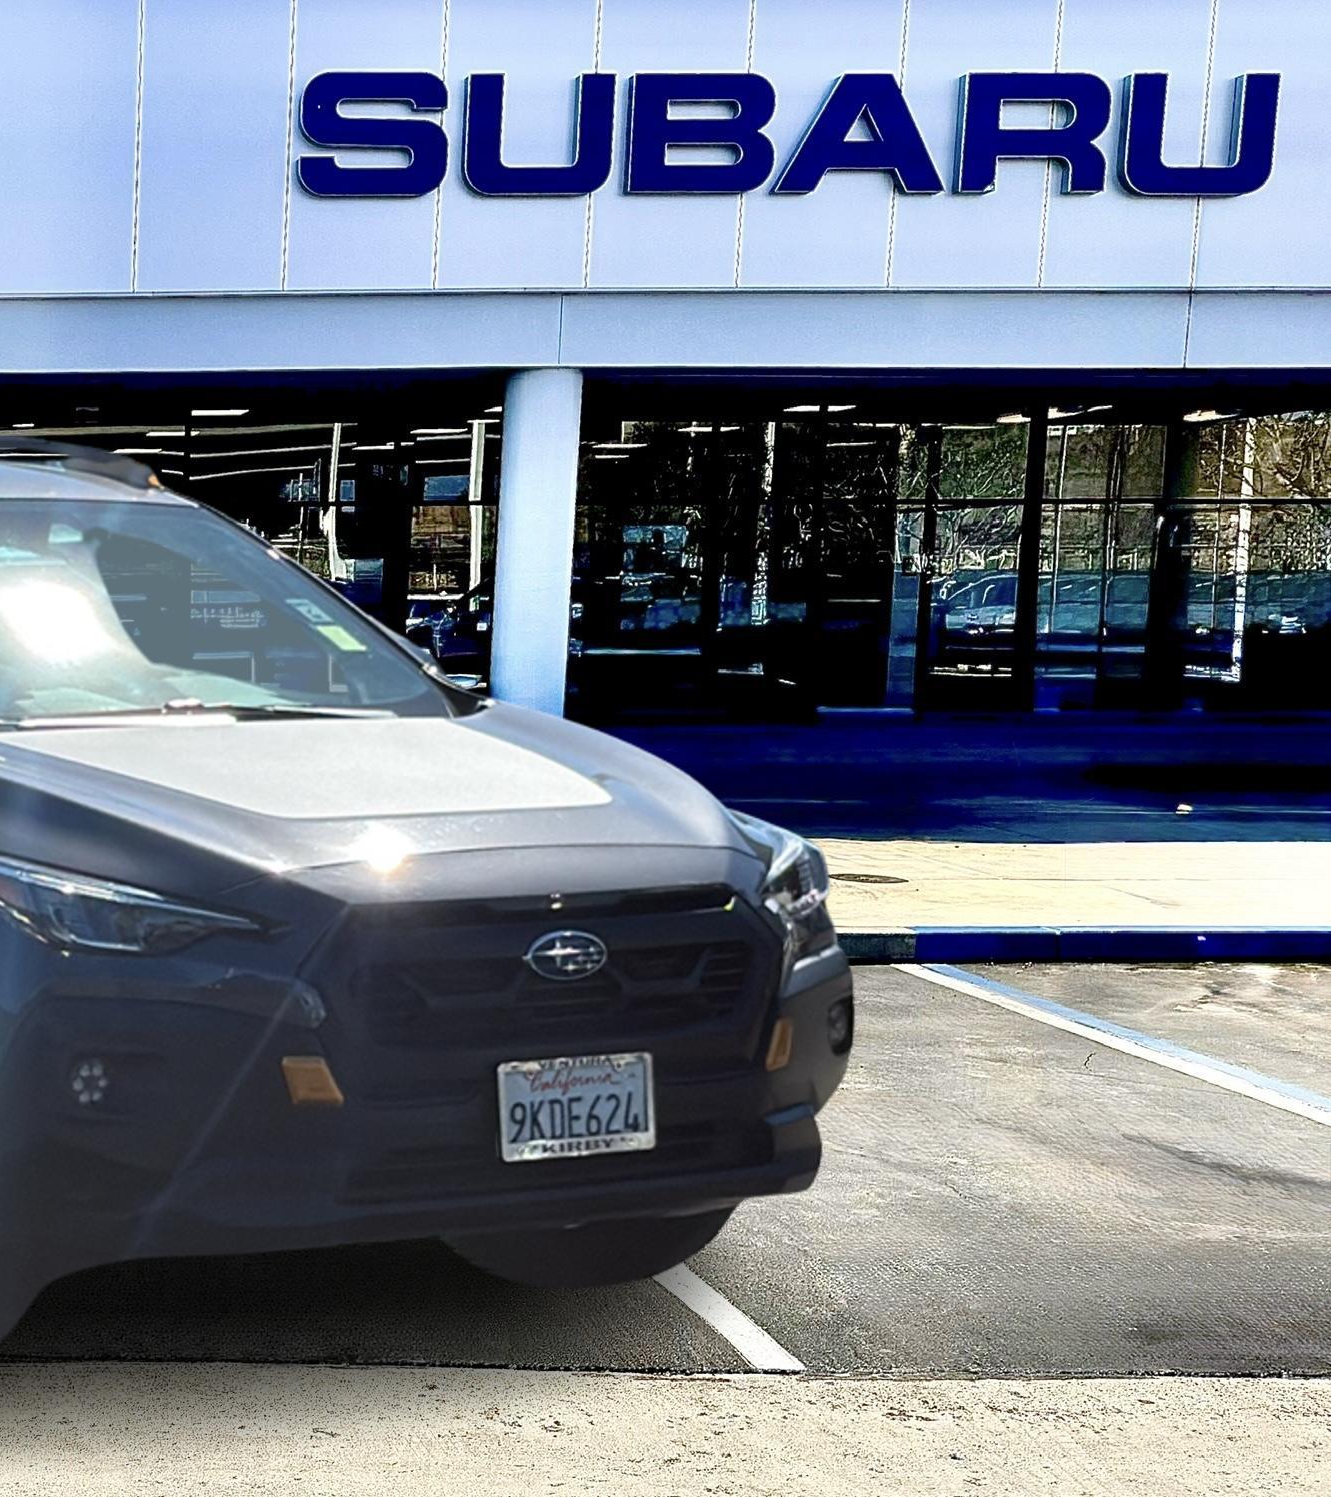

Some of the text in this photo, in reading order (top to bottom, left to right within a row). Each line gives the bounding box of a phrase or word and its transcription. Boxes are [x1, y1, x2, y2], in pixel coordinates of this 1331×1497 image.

[297, 71, 1281, 197] SUBARU
[530, 1071, 621, 1096] California
[509, 1091, 640, 1145] 9KDE624
[541, 1137, 614, 1154] KIRBY
